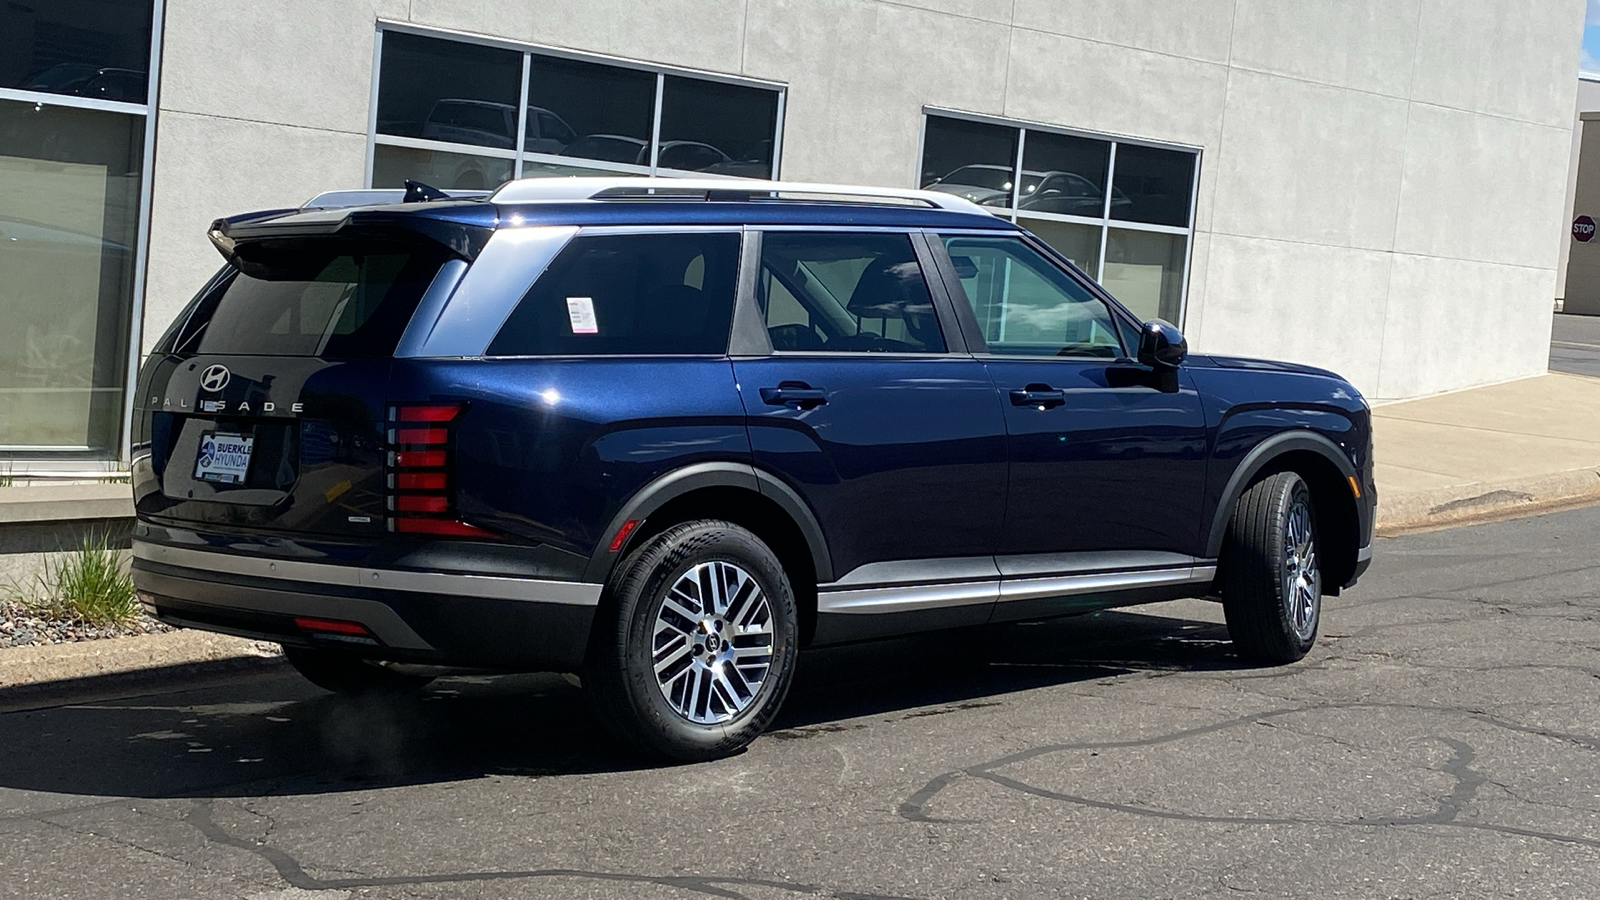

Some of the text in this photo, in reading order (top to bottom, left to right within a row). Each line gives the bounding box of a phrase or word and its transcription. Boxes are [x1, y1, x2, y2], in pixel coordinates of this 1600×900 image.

[1573, 223, 1594, 234] STOP
[151, 397, 303, 412] PALISADE
[217, 443, 252, 455] BUERKLE
[213, 453, 248, 468] HYUNDA
